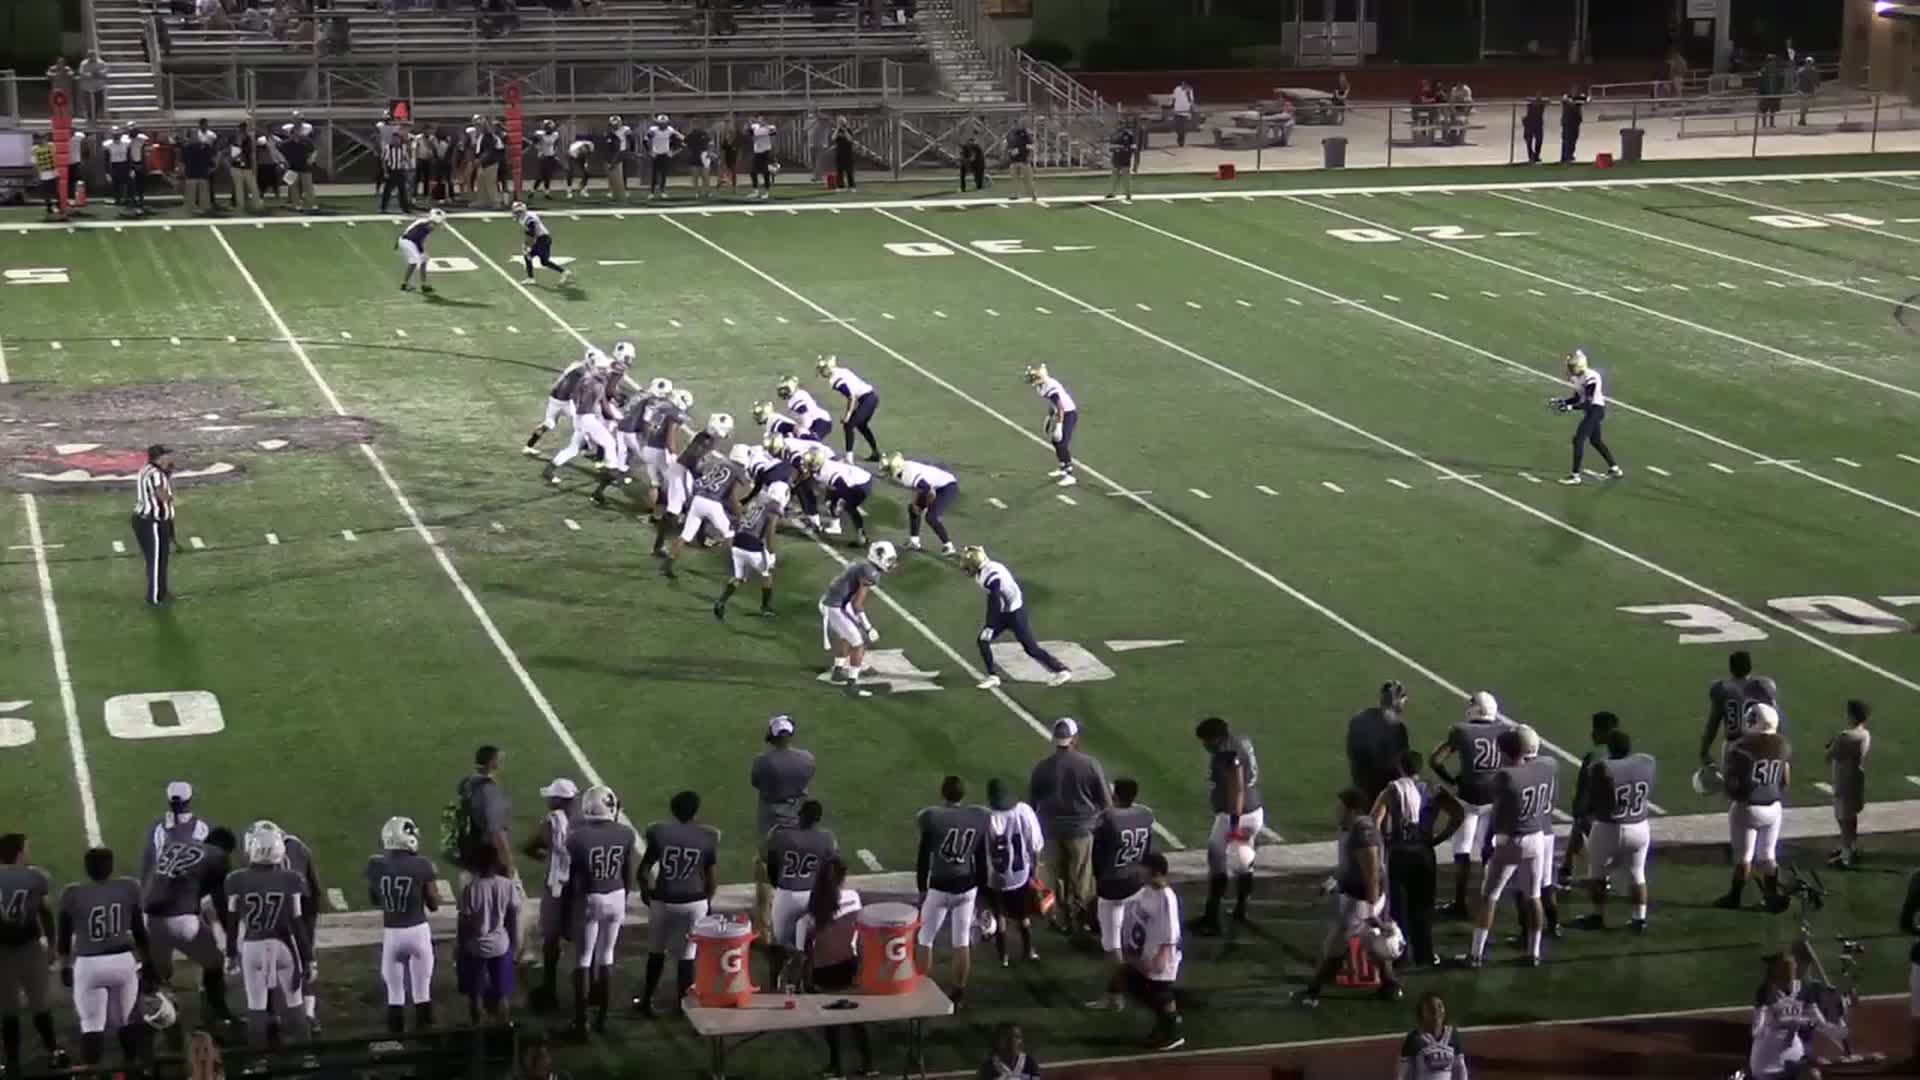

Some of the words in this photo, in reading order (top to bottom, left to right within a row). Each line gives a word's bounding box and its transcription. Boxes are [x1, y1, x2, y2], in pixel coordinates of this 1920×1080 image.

[662, 845, 701, 881] 57
[380, 875, 413, 913] 17
[88, 902, 122, 943] 61
[244, 891, 286, 936] 27
[720, 947, 743, 974] G
[884, 936, 908, 963] G
